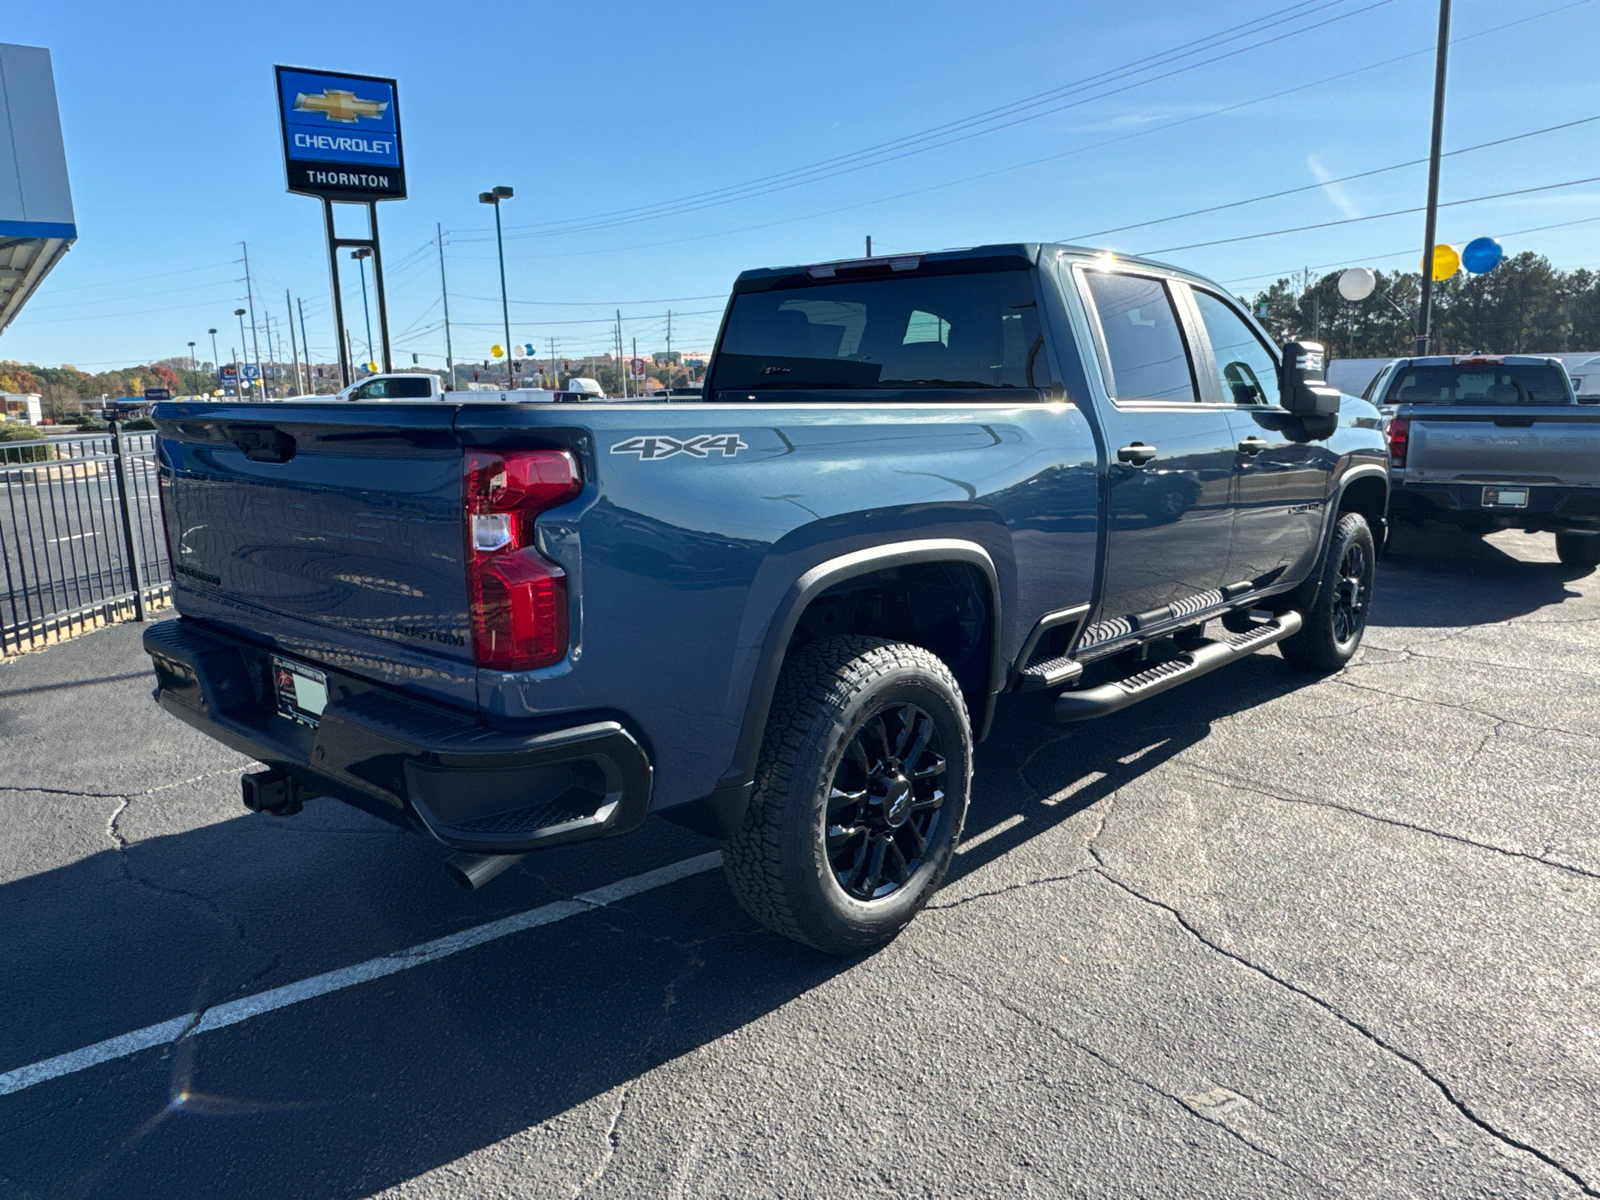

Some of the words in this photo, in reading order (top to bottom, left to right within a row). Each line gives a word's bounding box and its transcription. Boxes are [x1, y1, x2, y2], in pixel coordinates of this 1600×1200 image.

[294, 133, 392, 155] CHEVROLET
[306, 170, 389, 188] THORNTON
[610, 434, 749, 461] 4X4
